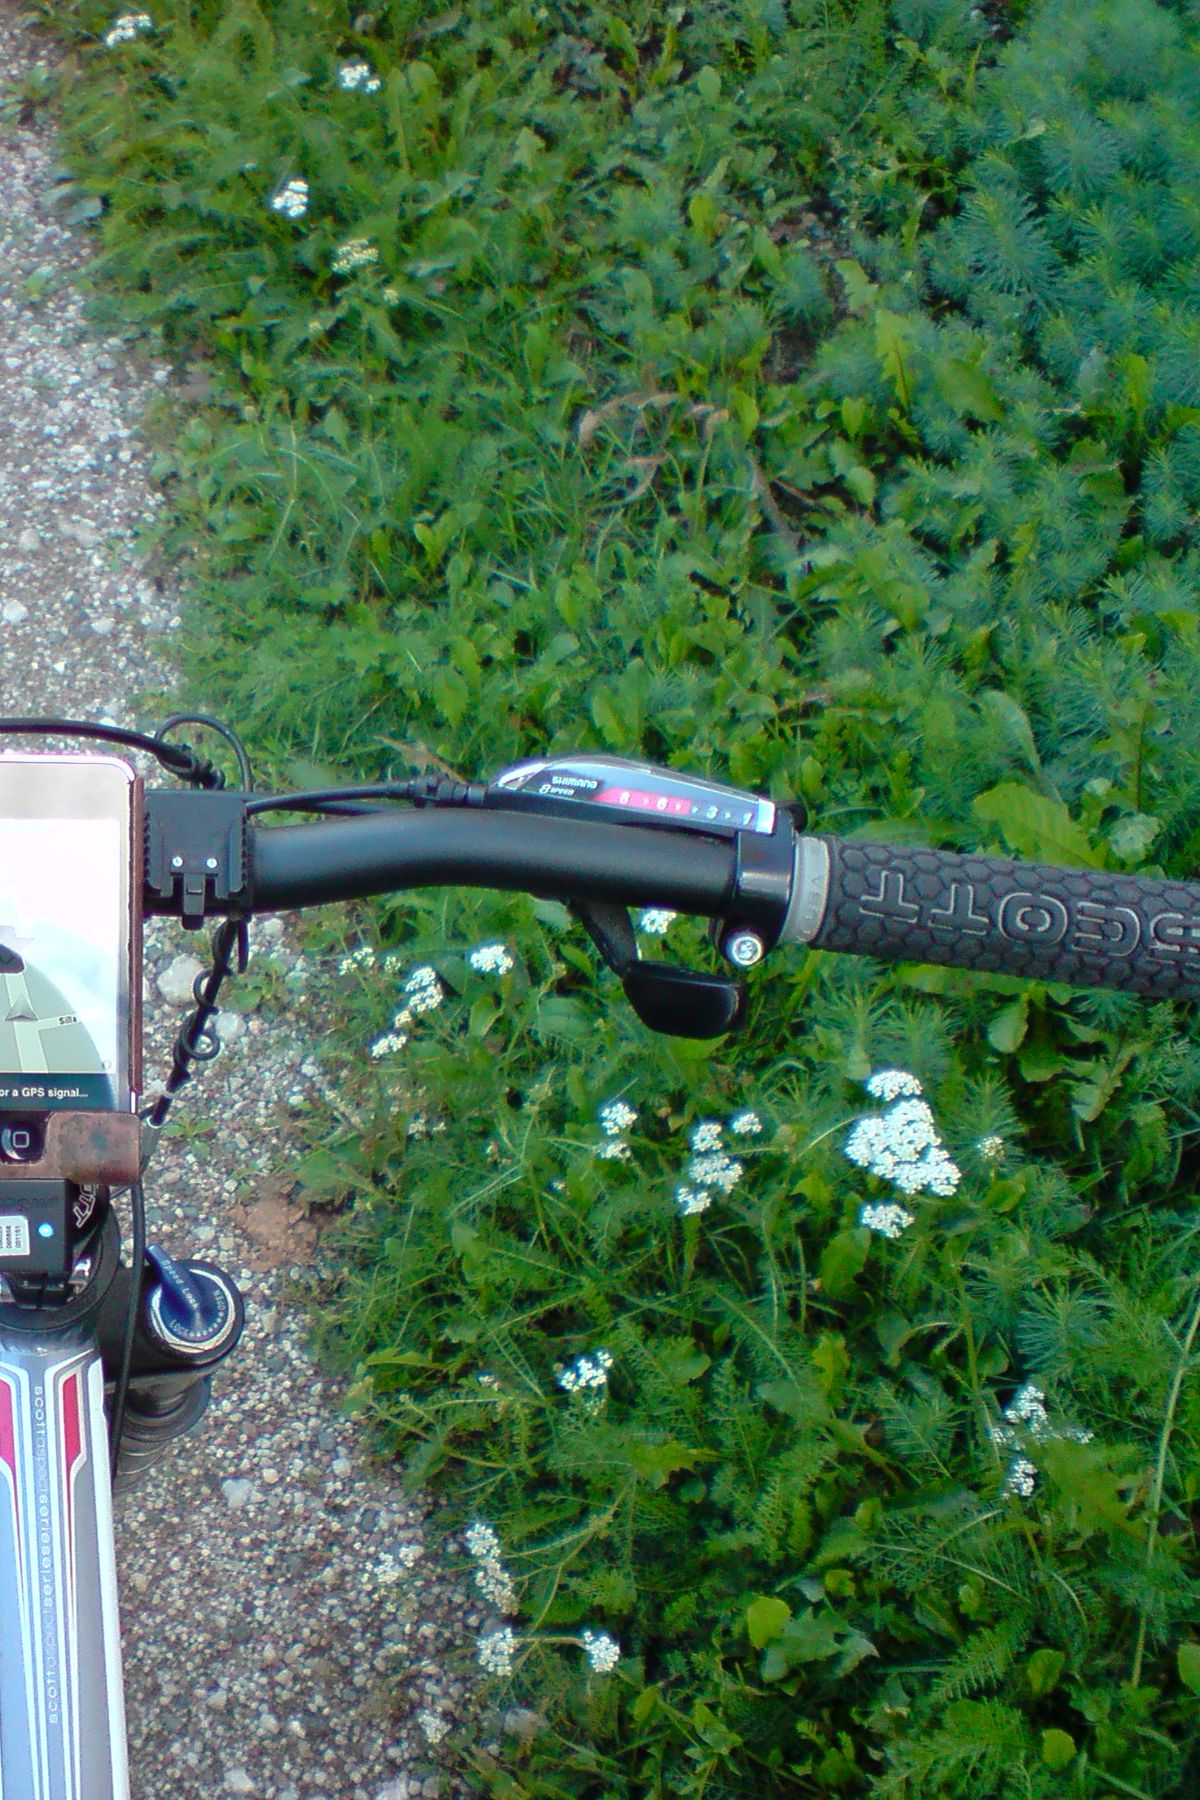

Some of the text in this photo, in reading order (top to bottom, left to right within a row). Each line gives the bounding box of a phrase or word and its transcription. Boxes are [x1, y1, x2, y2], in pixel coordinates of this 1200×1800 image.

[551, 775, 599, 790] SHIMANO
[11, 1089, 19, 1097] a
[21, 1087, 45, 1097] GPS
